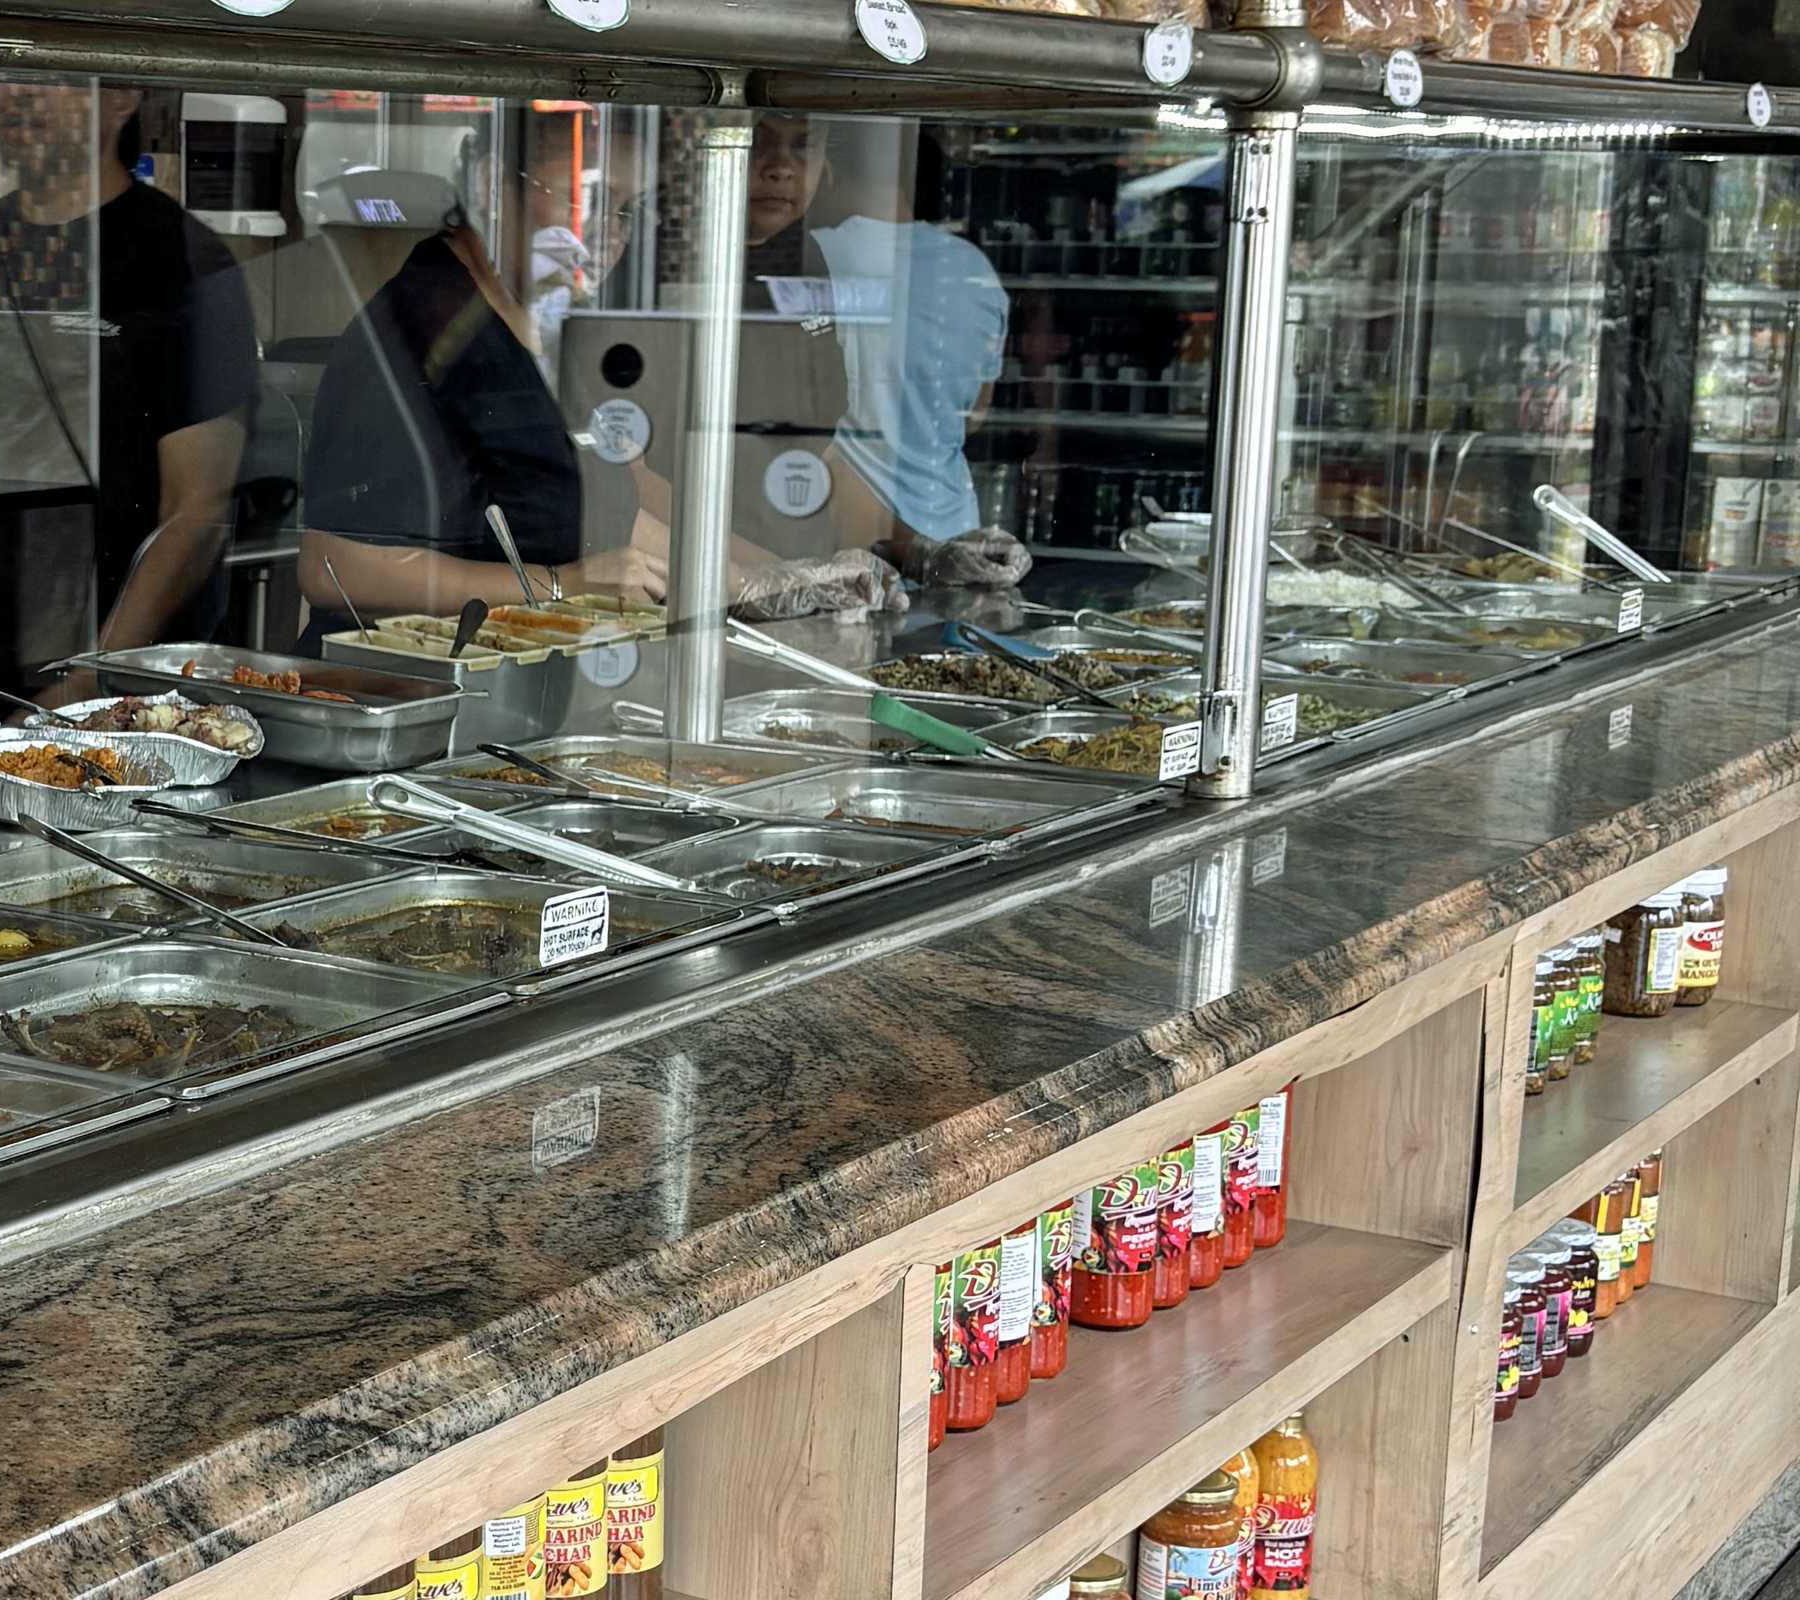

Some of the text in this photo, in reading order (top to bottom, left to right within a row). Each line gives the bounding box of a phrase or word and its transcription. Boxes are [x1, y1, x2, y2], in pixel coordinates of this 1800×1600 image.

[552, 899, 598, 922] WARNING
[559, 926, 589, 943] SURFACE
[1265, 1548, 1303, 1559] HOT
[1264, 1559, 1303, 1567] SAUCE
